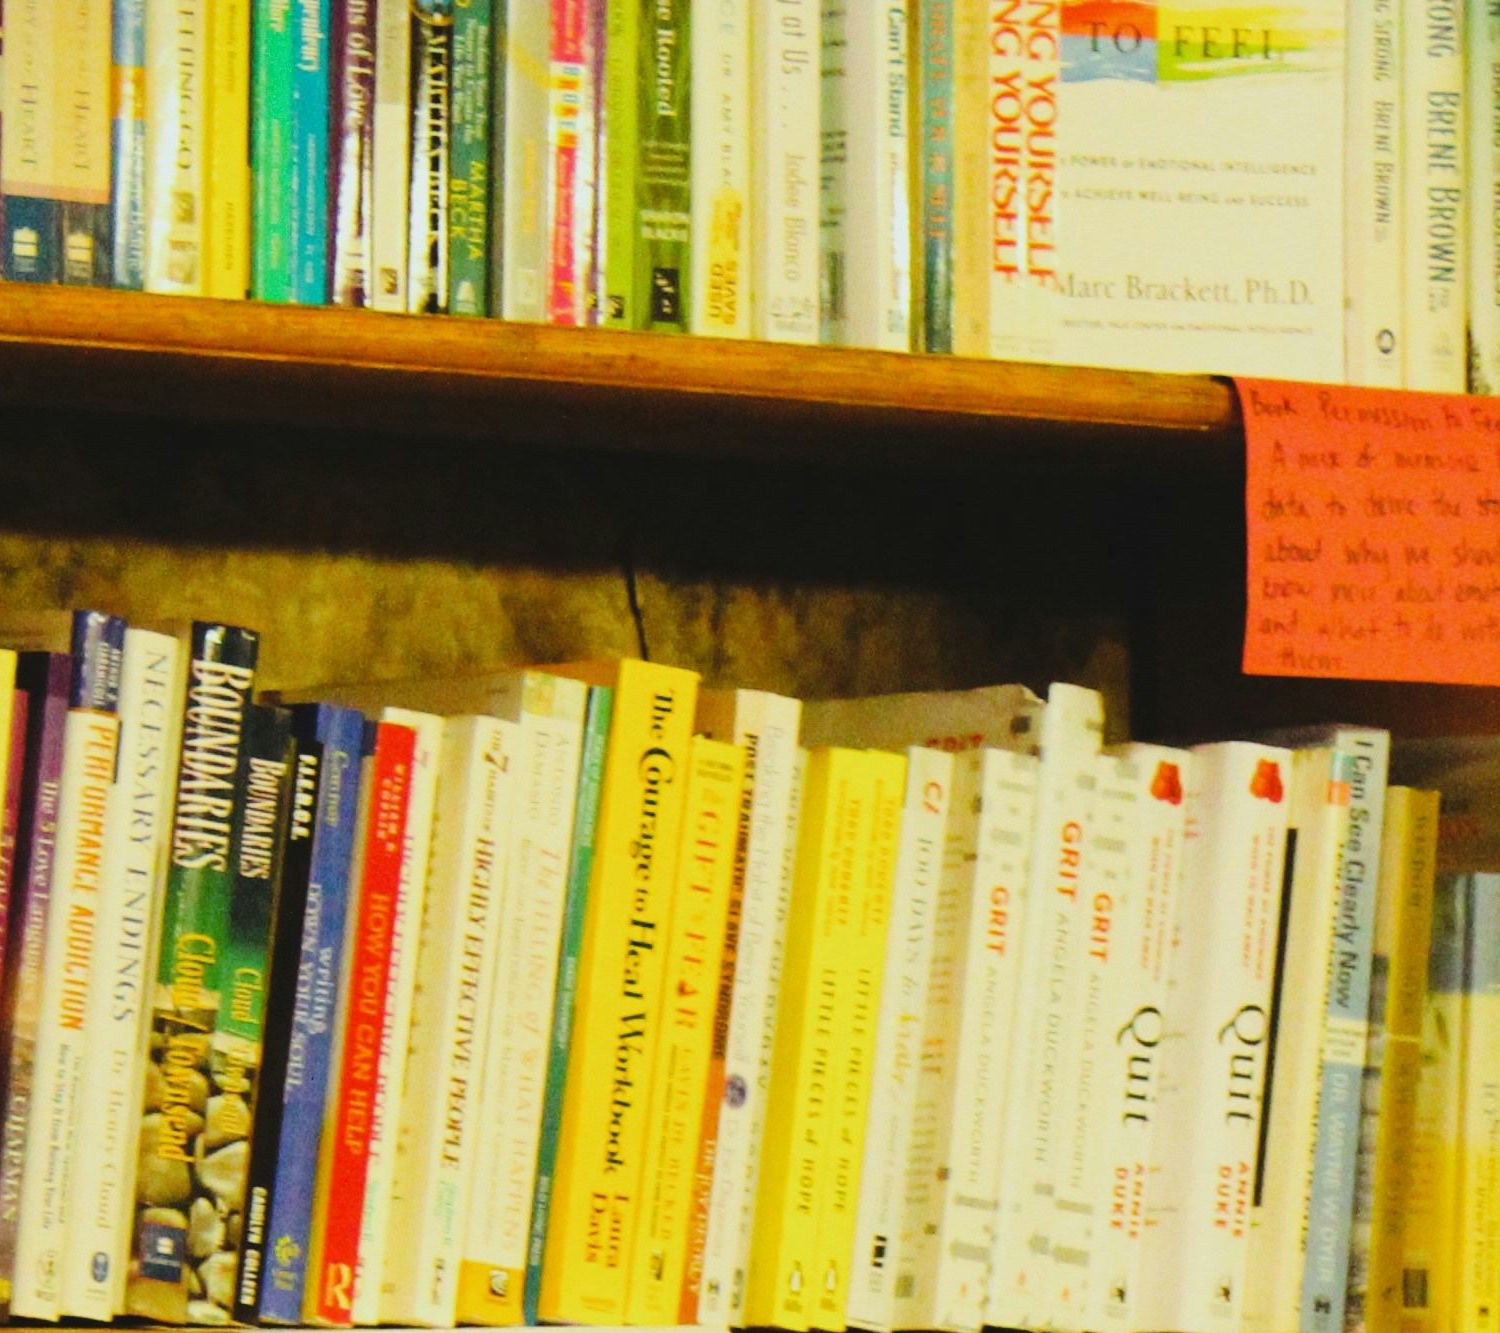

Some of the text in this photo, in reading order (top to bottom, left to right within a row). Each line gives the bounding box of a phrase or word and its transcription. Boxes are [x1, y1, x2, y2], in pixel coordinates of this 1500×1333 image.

[171, 659, 252, 873] BOUNDARIES
[1350, 753, 1373, 802] Can
[111, 653, 168, 1022] NECESSARY ENDINGS
[1347, 807, 1368, 851] See
[1335, 858, 1367, 945] Clearly
[173, 933, 216, 1010] Cloud
[584, 688, 674, 1270] The Courage to Heal Workbook Laura Davis
[1334, 951, 1357, 1009] Now
[158, 1040, 213, 1162] Townsend
[1219, 1003, 1267, 1128] Quit
[1324, 1111, 1348, 1188] WAYNE
[1212, 1165, 1232, 1230] DUKE
[1229, 1161, 1250, 1240] ANNIE
[1316, 1227, 1338, 1283] DYER
